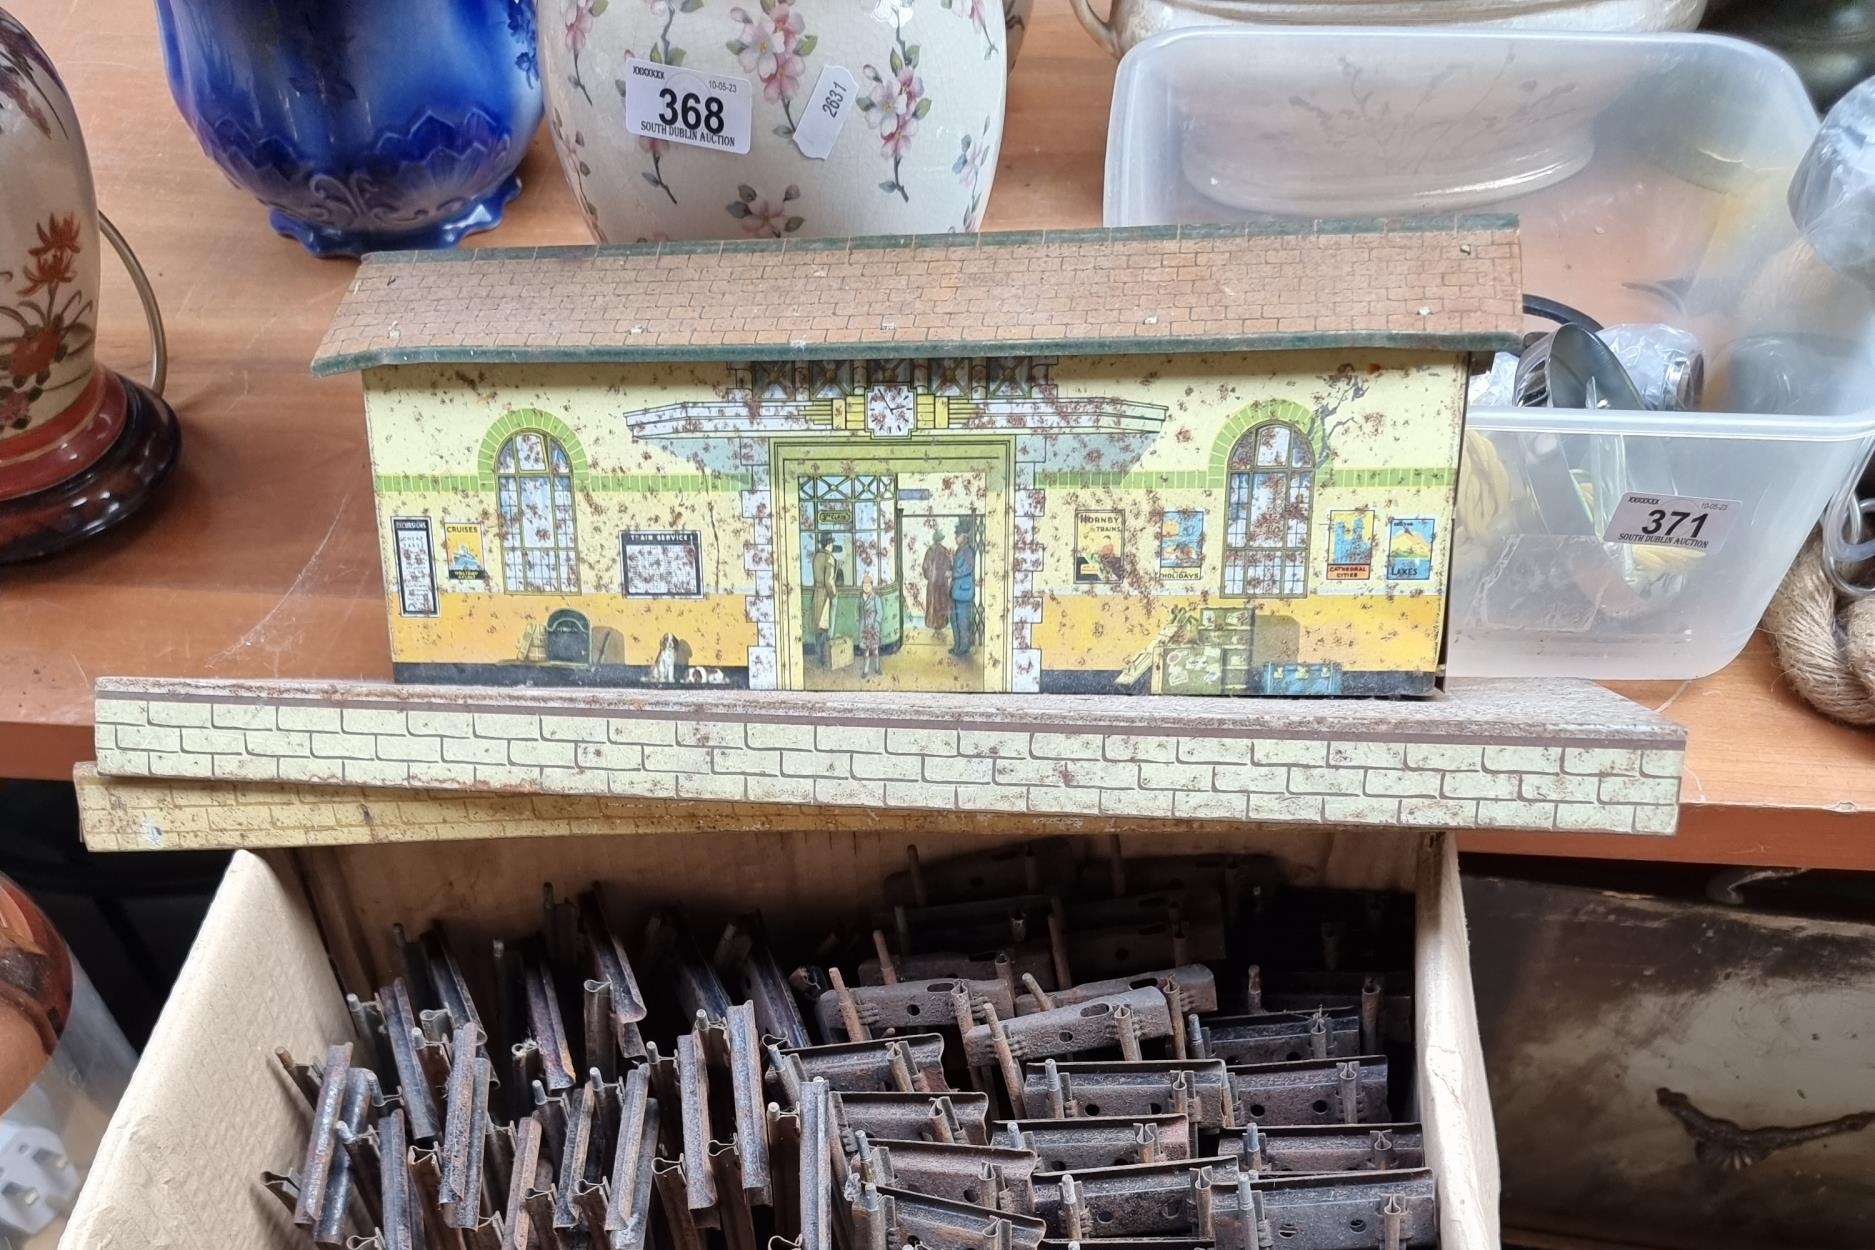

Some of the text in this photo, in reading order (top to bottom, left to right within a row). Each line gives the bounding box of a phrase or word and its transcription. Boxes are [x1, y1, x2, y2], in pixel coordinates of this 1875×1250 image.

[708, 80, 737, 93] 10-05-23
[822, 81, 847, 118] 2631
[658, 88, 725, 134] 368
[640, 120, 735, 147] SOUTH DUBLIN AUCTION
[1701, 502, 1728, 511] 10-05-23
[1080, 514, 1120, 524] HORNBY
[1641, 509, 1709, 538] 371
[1617, 533, 1709, 549] SOUTH DUBLIN AUCTION
